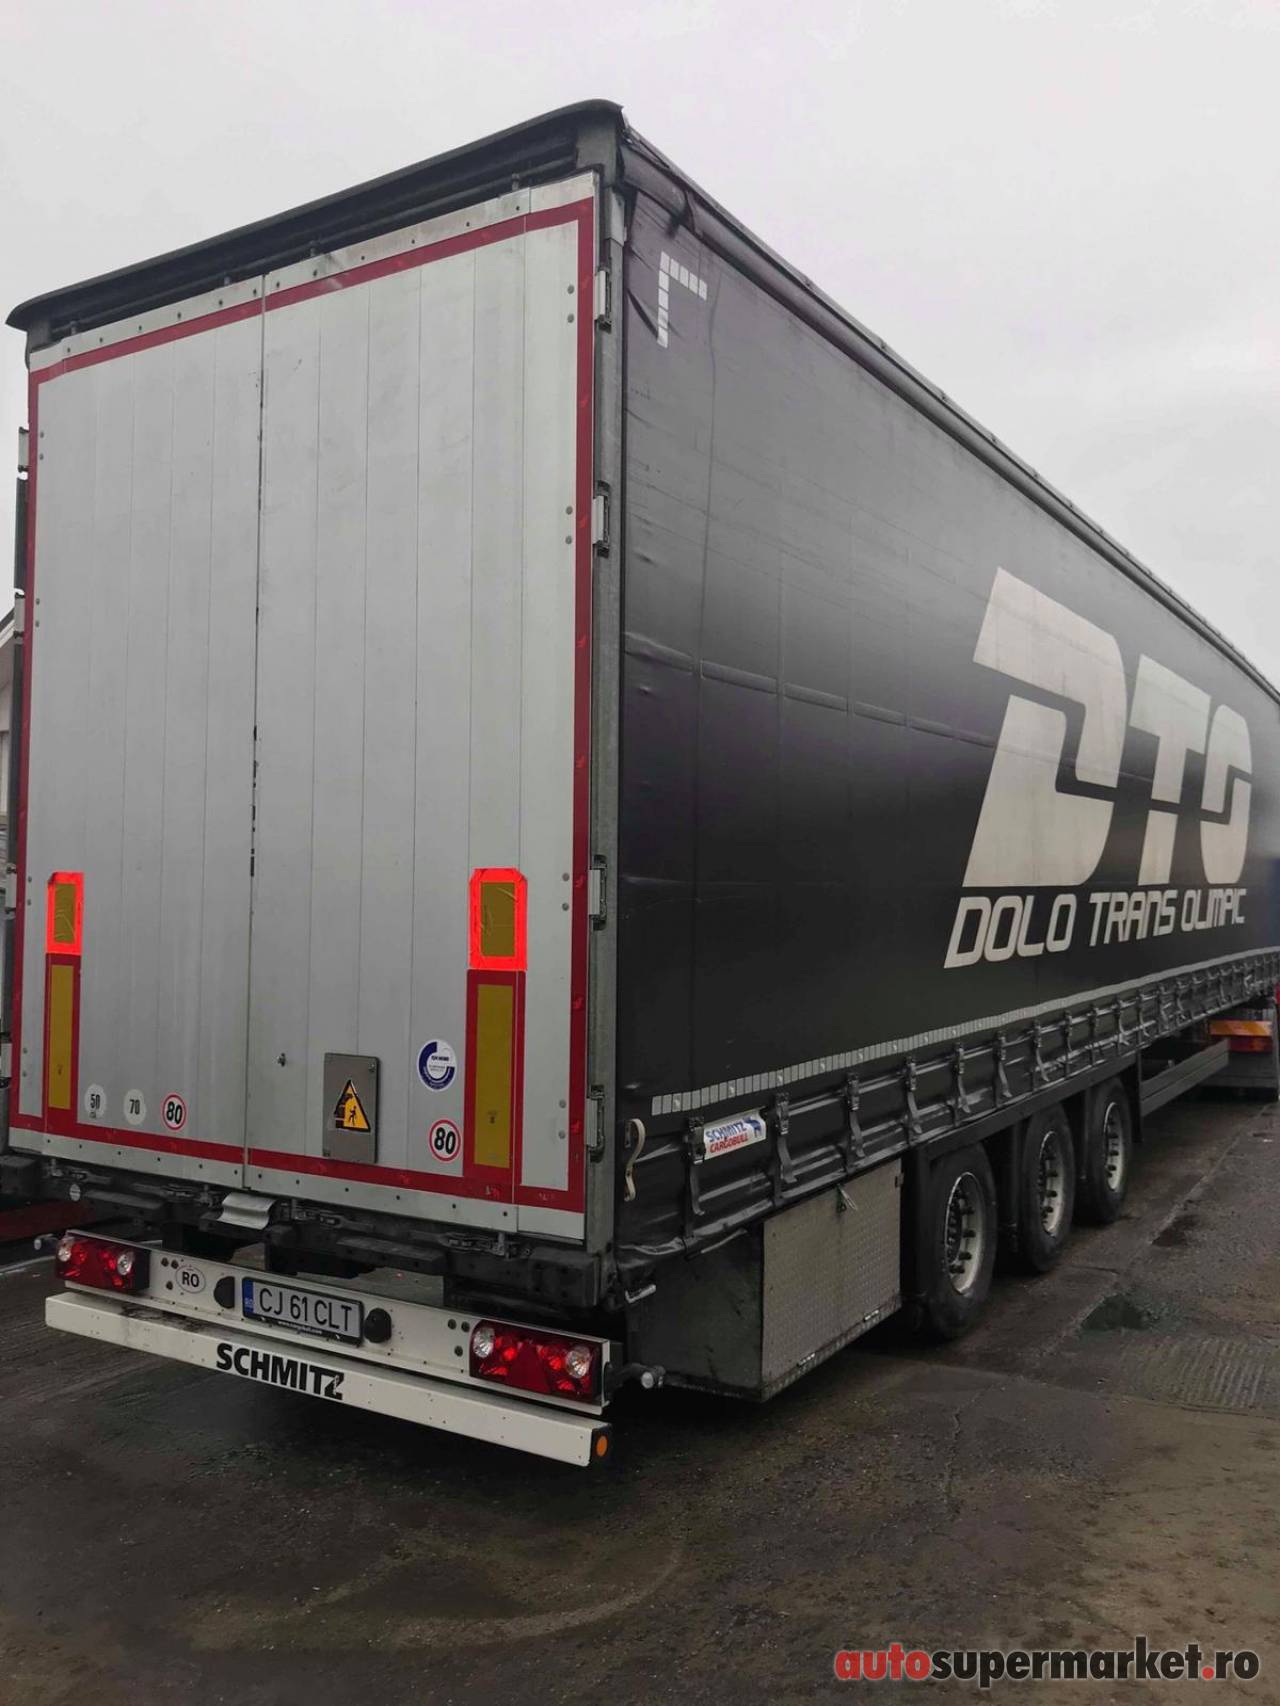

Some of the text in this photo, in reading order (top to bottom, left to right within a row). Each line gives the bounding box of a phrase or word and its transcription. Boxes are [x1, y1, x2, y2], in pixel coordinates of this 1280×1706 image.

[943, 893, 1077, 969] DOLO
[1088, 889, 1178, 947] TRANS
[90, 1093, 101, 1110] 50
[129, 1098, 140, 1115] 70
[166, 1101, 183, 1125] 80
[434, 1127, 456, 1155] 80
[705, 1121, 747, 1143] SCHMITZ
[182, 1271, 199, 1288] RO
[259, 1287, 283, 1316] CJ
[290, 1294, 308, 1322] 61
[314, 1299, 352, 1332] CLT
[216, 1342, 345, 1401] SCHMITZ
